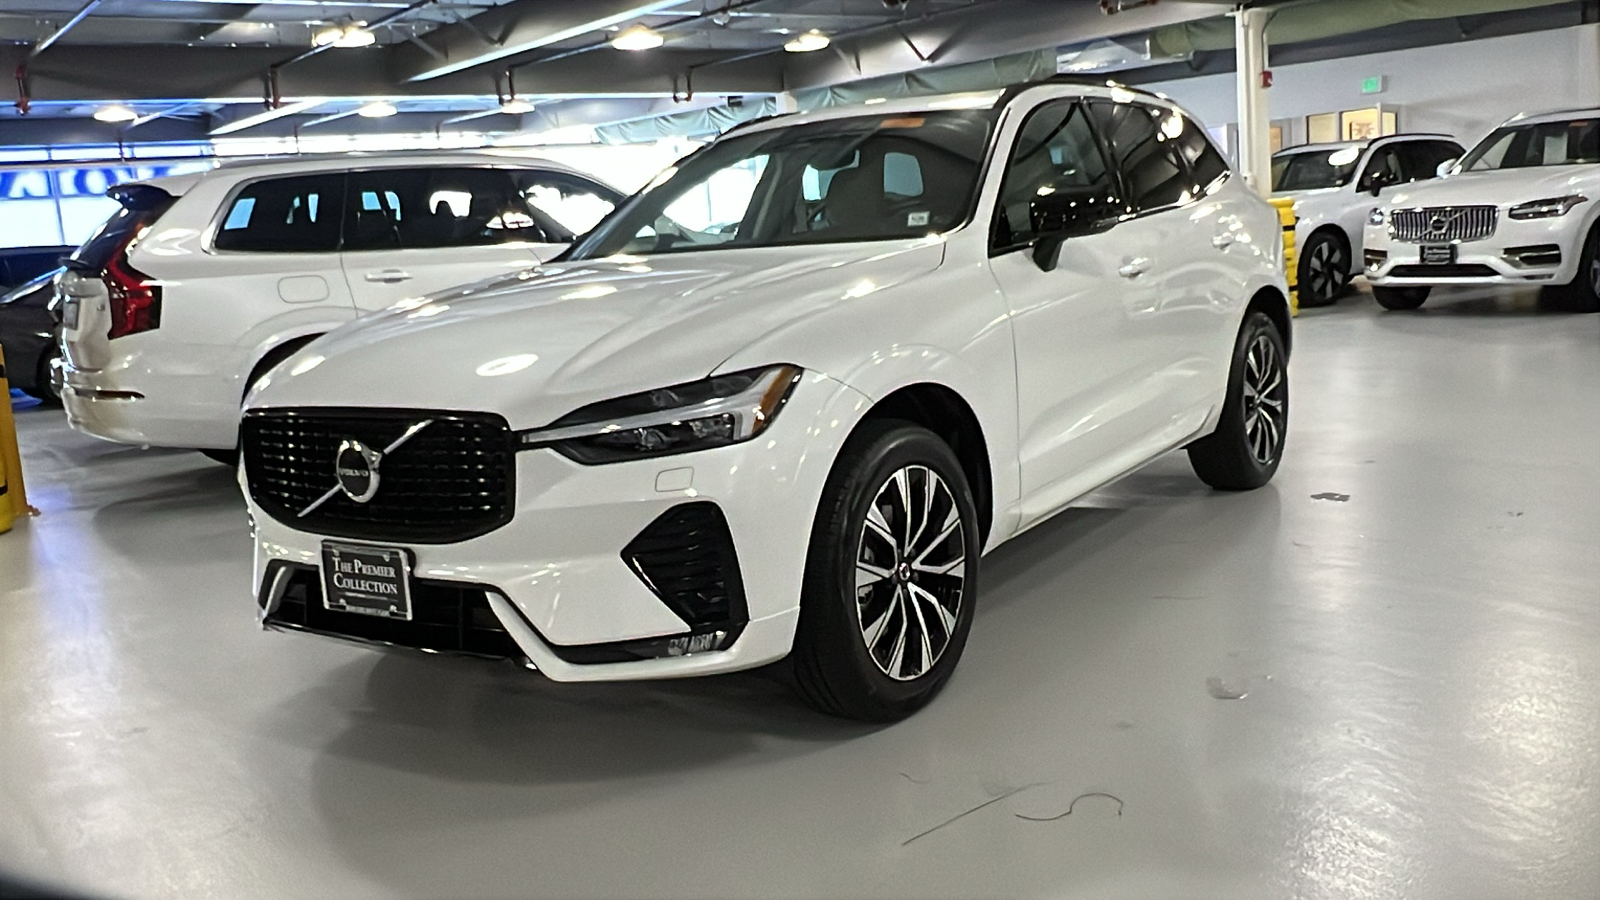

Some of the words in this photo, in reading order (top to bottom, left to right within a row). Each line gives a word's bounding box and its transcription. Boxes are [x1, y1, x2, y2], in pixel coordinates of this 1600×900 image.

[332, 556, 353, 574] THE
[353, 559, 396, 578] PREMIER
[333, 572, 398, 595] COLLECTION
